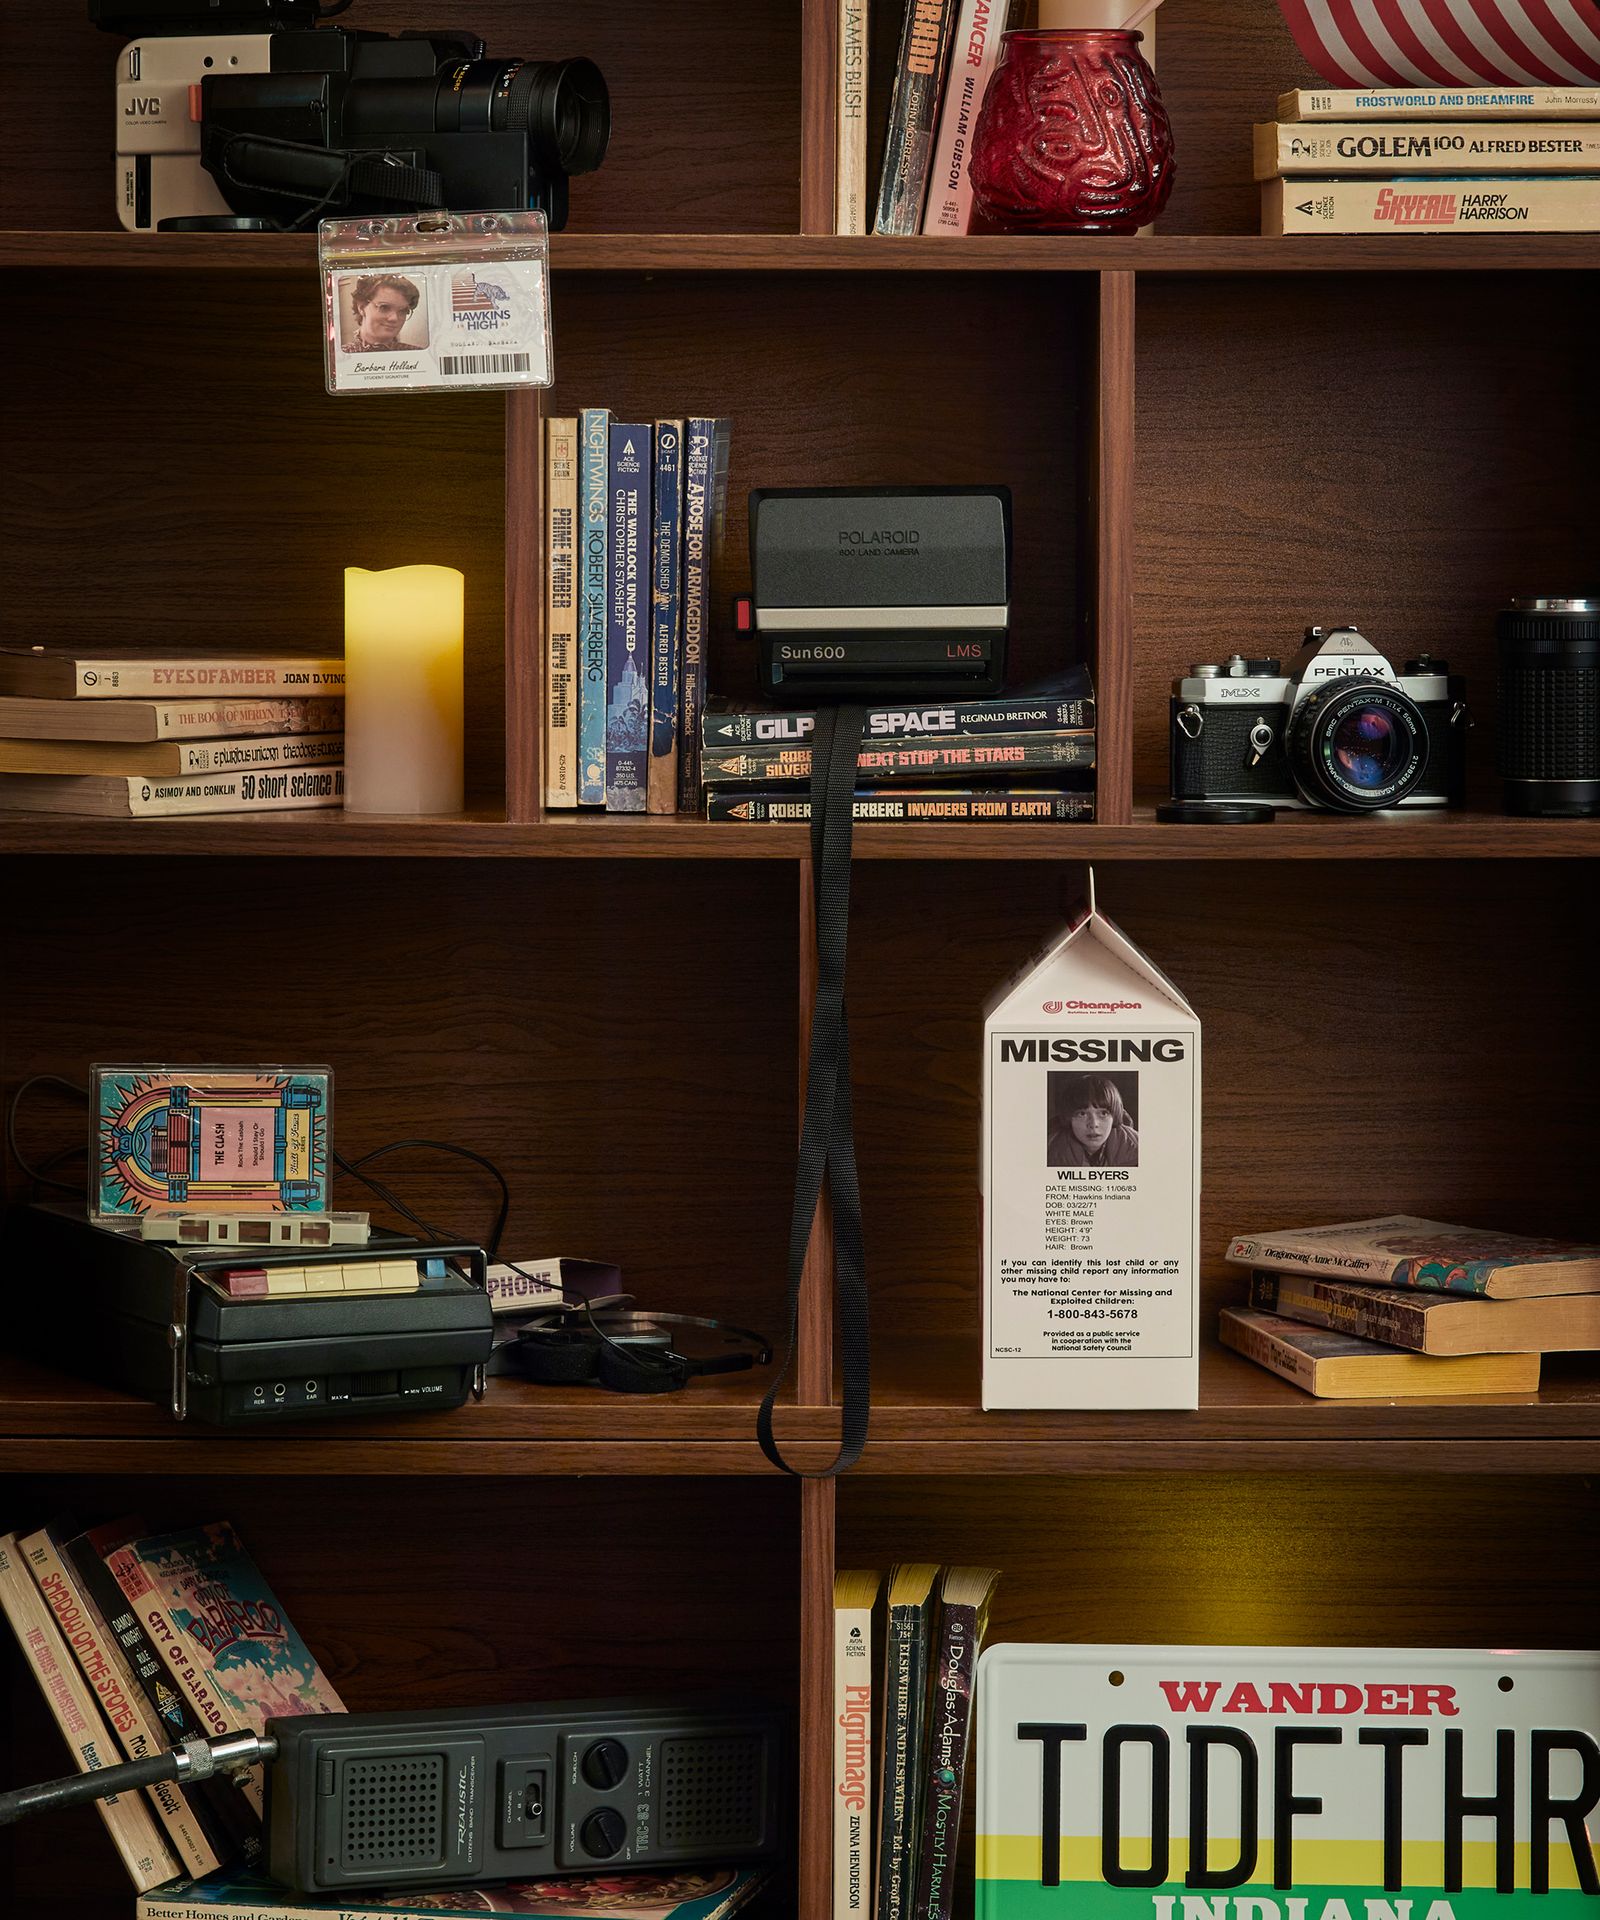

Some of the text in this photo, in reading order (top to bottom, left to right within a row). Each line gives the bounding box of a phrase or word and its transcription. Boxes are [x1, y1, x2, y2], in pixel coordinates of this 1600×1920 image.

[966, 0, 992, 68] ANCER
[845, 5, 862, 118] JAMES BLISH
[125, 98, 160, 115] JVC
[907, 88, 920, 120] JOHN
[1355, 94, 1535, 108] FROSTWORLD AND DREAMFIRE
[948, 77, 975, 190] WILLIAM GIBSON
[1469, 141, 1526, 153] ALFRED
[1529, 140, 1583, 153] BESTER
[1462, 195, 1507, 207] HARRY
[1459, 207, 1529, 220] HARRISON
[453, 310, 511, 322] HAWKINS
[467, 320, 498, 331] HIGH
[354, 360, 419, 373] Barbara Holland
[660, 464, 675, 472] 4461
[839, 530, 920, 544] POLAROID
[587, 414, 604, 682] NIGHTWINGS ROBERT SILVERBERG
[858, 547, 920, 556] LAND CAMERA
[614, 489, 626, 626] CHRISTOPHER STASHEFF
[626, 489, 637, 652] THE WARLOCK UNLOCKED
[658, 521, 671, 686] THE DEMOLISHED ALFRED BESTER
[686, 565, 703, 664] ARMAGEDDON
[947, 644, 982, 658] LMS
[153, 668, 310, 684] EYES OF AMBER JOAN
[1314, 667, 1385, 677] PENTAX
[685, 674, 696, 701] Hilbert
[179, 714, 197, 725] THE
[198, 711, 225, 723] BOOK
[226, 710, 239, 721] OF
[240, 709, 274, 720] MERLYN
[870, 710, 1048, 734] SPACE REGINALD BRETNOR
[1402, 712, 1417, 735] 50mm
[857, 747, 1025, 767] NEXT STOP THE STARS
[154, 786, 183, 798] ASIMOV
[186, 786, 201, 797] AND
[204, 785, 236, 796] CONKLIN
[242, 775, 255, 800] 50
[258, 774, 288, 799] short
[291, 772, 332, 798] science
[907, 802, 968, 817] INVADERS
[971, 802, 1007, 816] FROM
[1011, 801, 1051, 816] EARTH
[1066, 1000, 1142, 1012] Champion
[1001, 1039, 1185, 1063] MISSING
[215, 1123, 225, 1165] THE CLASH
[252, 1131, 260, 1143] Stay
[1057, 1171, 1129, 1181] WILL BYERS
[1045, 1193, 1131, 1201] FROM: Hawkins Indiana
[1051, 1259, 1083, 1269] identify
[1264, 1248, 1372, 1272] Dragonsong Anne McCaffrey
[1000, 1267, 1180, 1277] other missing report information
[1031, 1289, 1153, 1298] National Center Missing
[1050, 1297, 1135, 1306] Exploited Children:
[1047, 1309, 1138, 1319] 1-800-843-5678
[1043, 1330, 1075, 1338] Provided
[1060, 1337, 1103, 1346] cooperation
[1083, 1344, 1106, 1352] Safety
[422, 1385, 443, 1393] VOLUME
[40, 1572, 86, 1634] SHADOW
[83, 1650, 111, 1682] THE
[112, 1612, 136, 1633] DAMON
[120, 1626, 144, 1648] KNIGHT
[148, 1611, 189, 1666] CITY OF
[136, 1649, 152, 1665] RULE
[140, 1661, 161, 1678] GOLDEN
[1159, 1680, 1460, 1716] WANDER
[893, 1643, 910, 1822] ELSEWHERE ELSEWHEN
[934, 1645, 964, 1851] Douglas Adams MOSTLY
[839, 1685, 871, 1909] Pilgrimage ZENNA HENDERSON
[636, 1803, 650, 1853] TRC-83
[147, 1907, 183, 1920] Better
